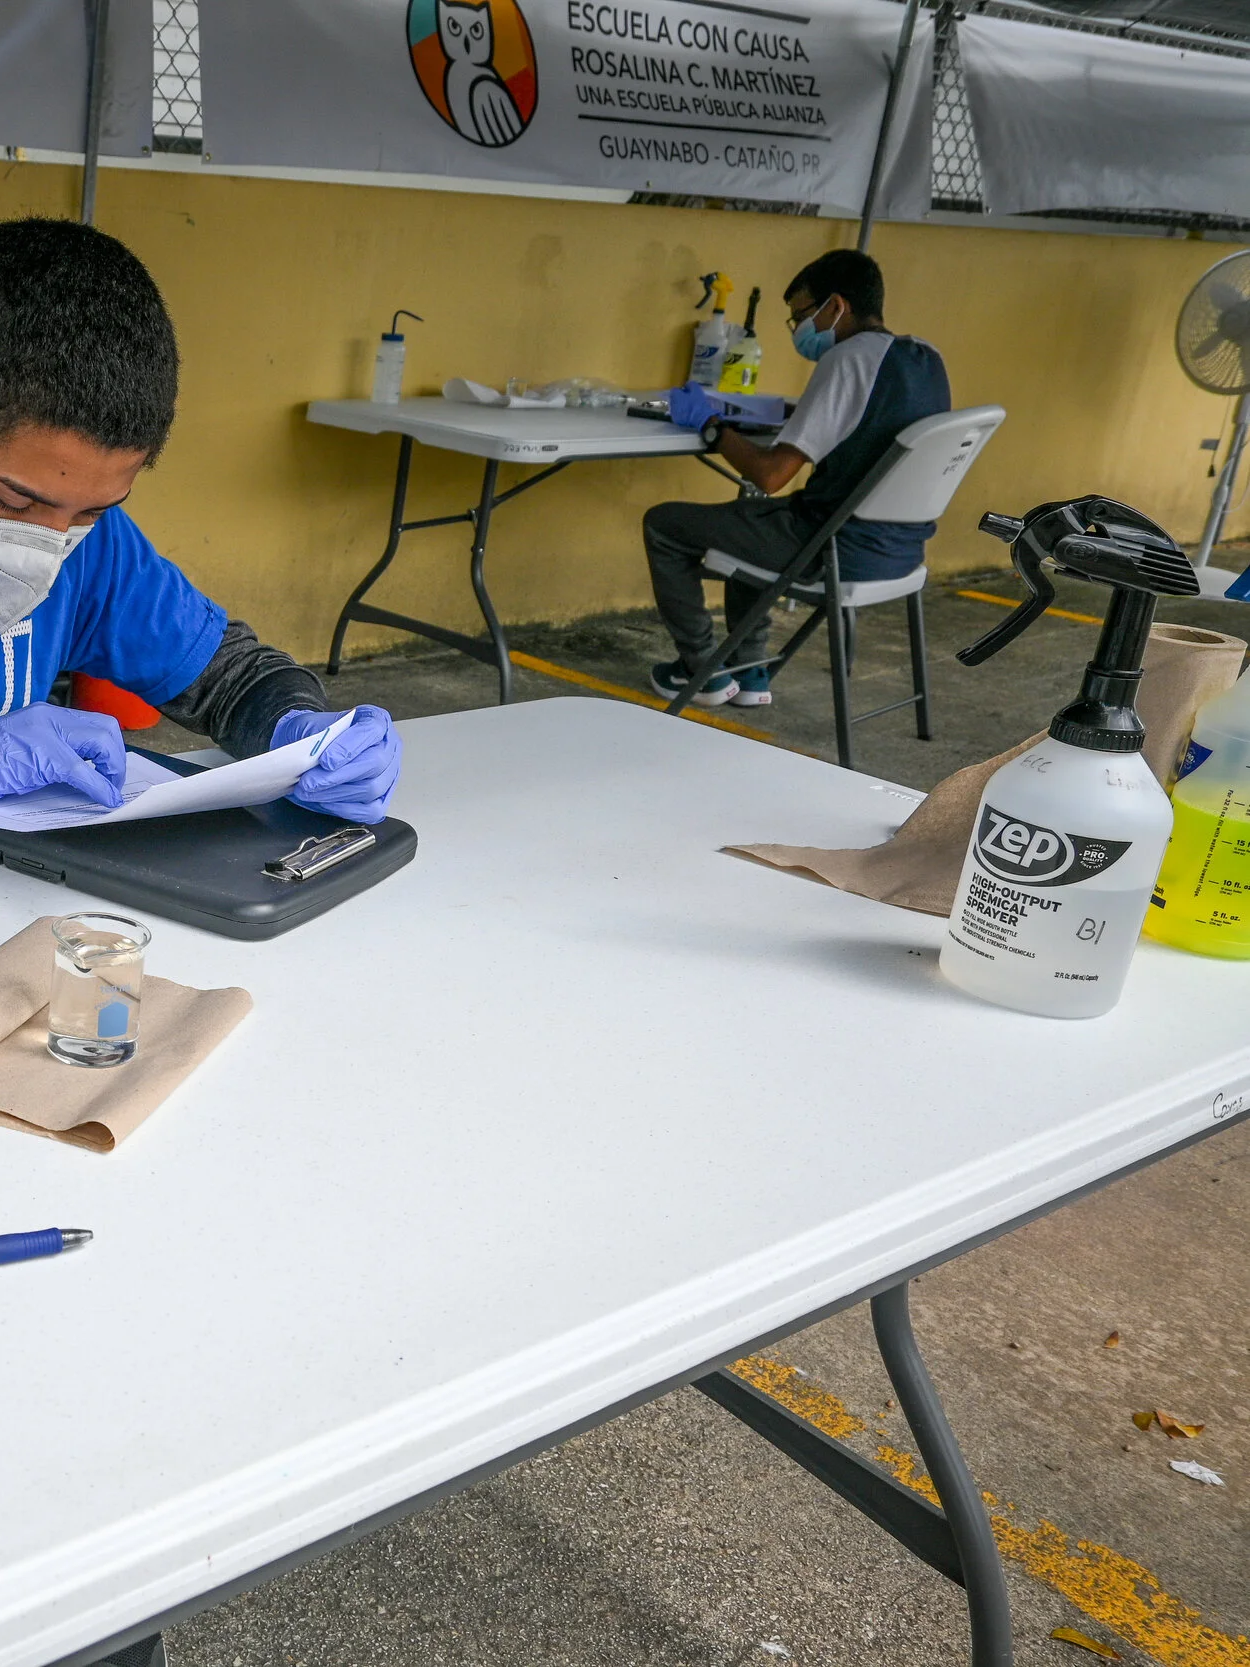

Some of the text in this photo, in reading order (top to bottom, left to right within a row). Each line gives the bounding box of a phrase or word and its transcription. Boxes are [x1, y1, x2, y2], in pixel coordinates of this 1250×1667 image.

[568, 1, 810, 63] ESCUELA CON CAUSA
[571, 46, 821, 97] ROSALINA C. MARTÍNEZ
[576, 84, 827, 126] UNA ESCUELA PÚBLICA ALIANZA
[600, 135, 709, 165] GUAYNABO
[724, 145, 799, 176] CATAÑO,
[802, 152, 821, 175] PR
[1083, 850, 1105, 859] PRO
[1208, 839, 1217, 852] water
[1236, 839, 1246, 847] 15
[1198, 868, 1208, 883] lowest
[1203, 860, 1211, 868] the
[969, 884, 1028, 917] CHEMICAL
[972, 872, 1062, 912] HIGH-OUTPUT
[966, 896, 1019, 927] SPRAYER
[966, 928, 986, 943] INDUSTRIAL
[986, 938, 1008, 950] STRENGTH
[1008, 946, 1036, 959] CHEMICALS
[979, 926, 1007, 943] PROFESSIONAL
[986, 919, 1000, 931] MOUTH
[1001, 927, 1018, 938] BOTTLE
